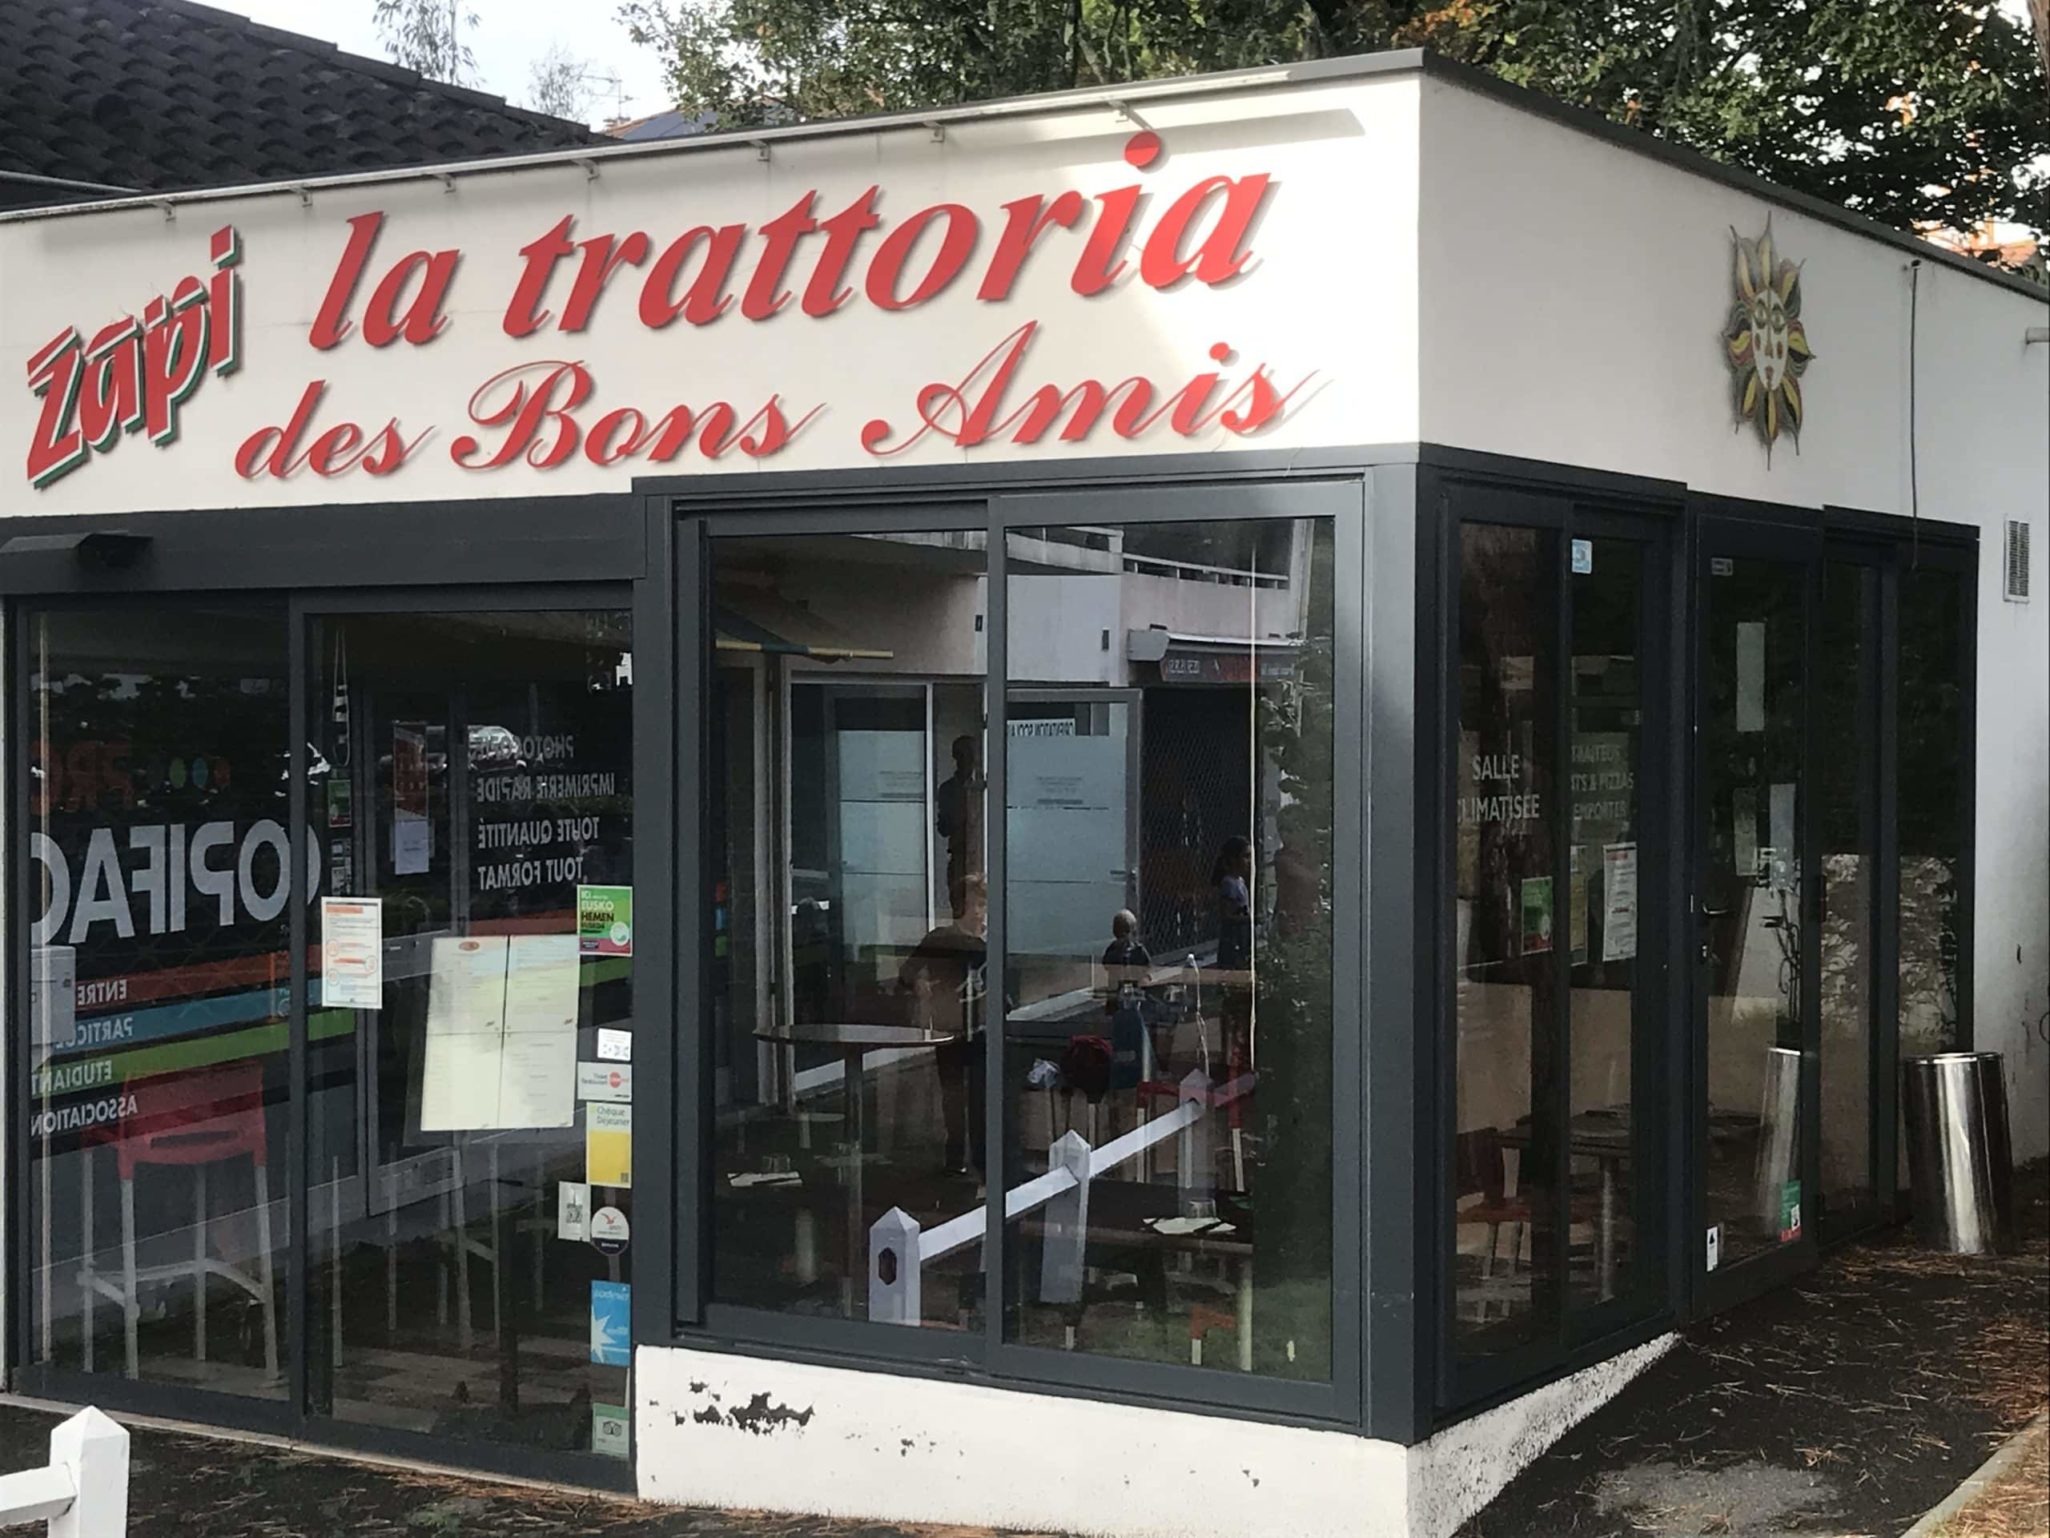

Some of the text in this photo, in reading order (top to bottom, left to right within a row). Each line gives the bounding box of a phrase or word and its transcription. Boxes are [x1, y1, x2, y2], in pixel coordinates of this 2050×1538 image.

[309, 130, 1272, 349] la trattoria
[235, 320, 1320, 480] des Bons Amis
[1471, 753, 1520, 780] SALLE
